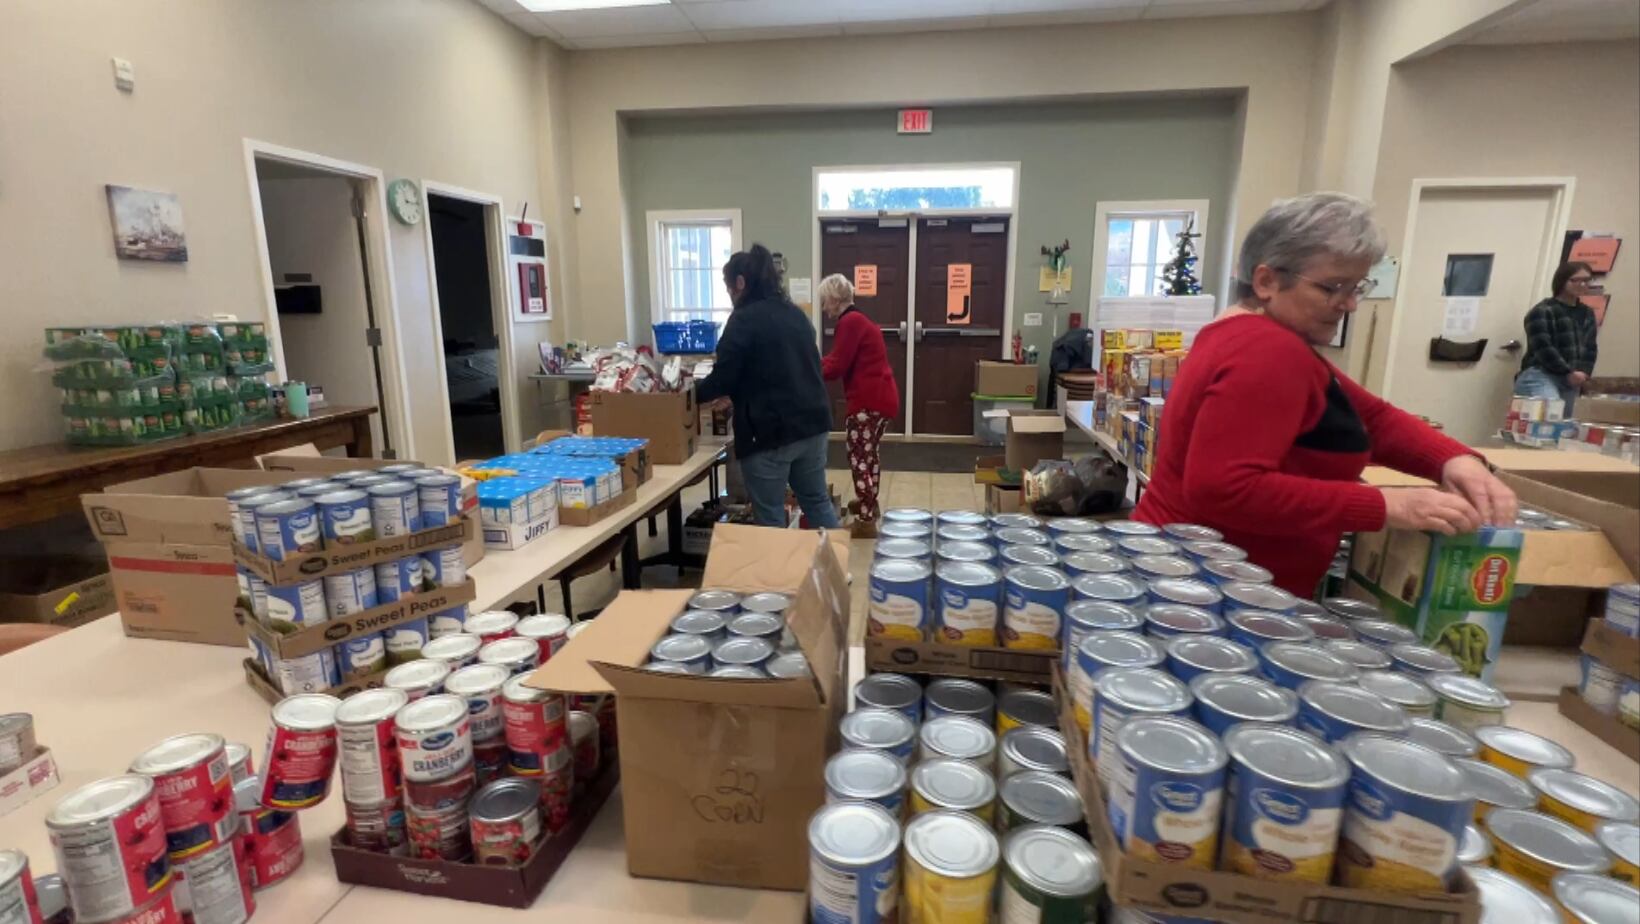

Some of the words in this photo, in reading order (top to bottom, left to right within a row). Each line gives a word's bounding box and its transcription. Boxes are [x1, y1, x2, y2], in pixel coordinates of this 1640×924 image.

[903, 111, 928, 130] EXIT
[525, 520, 550, 541] JIFFY
[331, 549, 371, 565] Sweet
[375, 543, 405, 557] Peas
[356, 607, 404, 632] Sweet
[410, 596, 447, 615] Peas
[413, 748, 465, 772] CRANBERRY
[715, 768, 757, 797] 22
